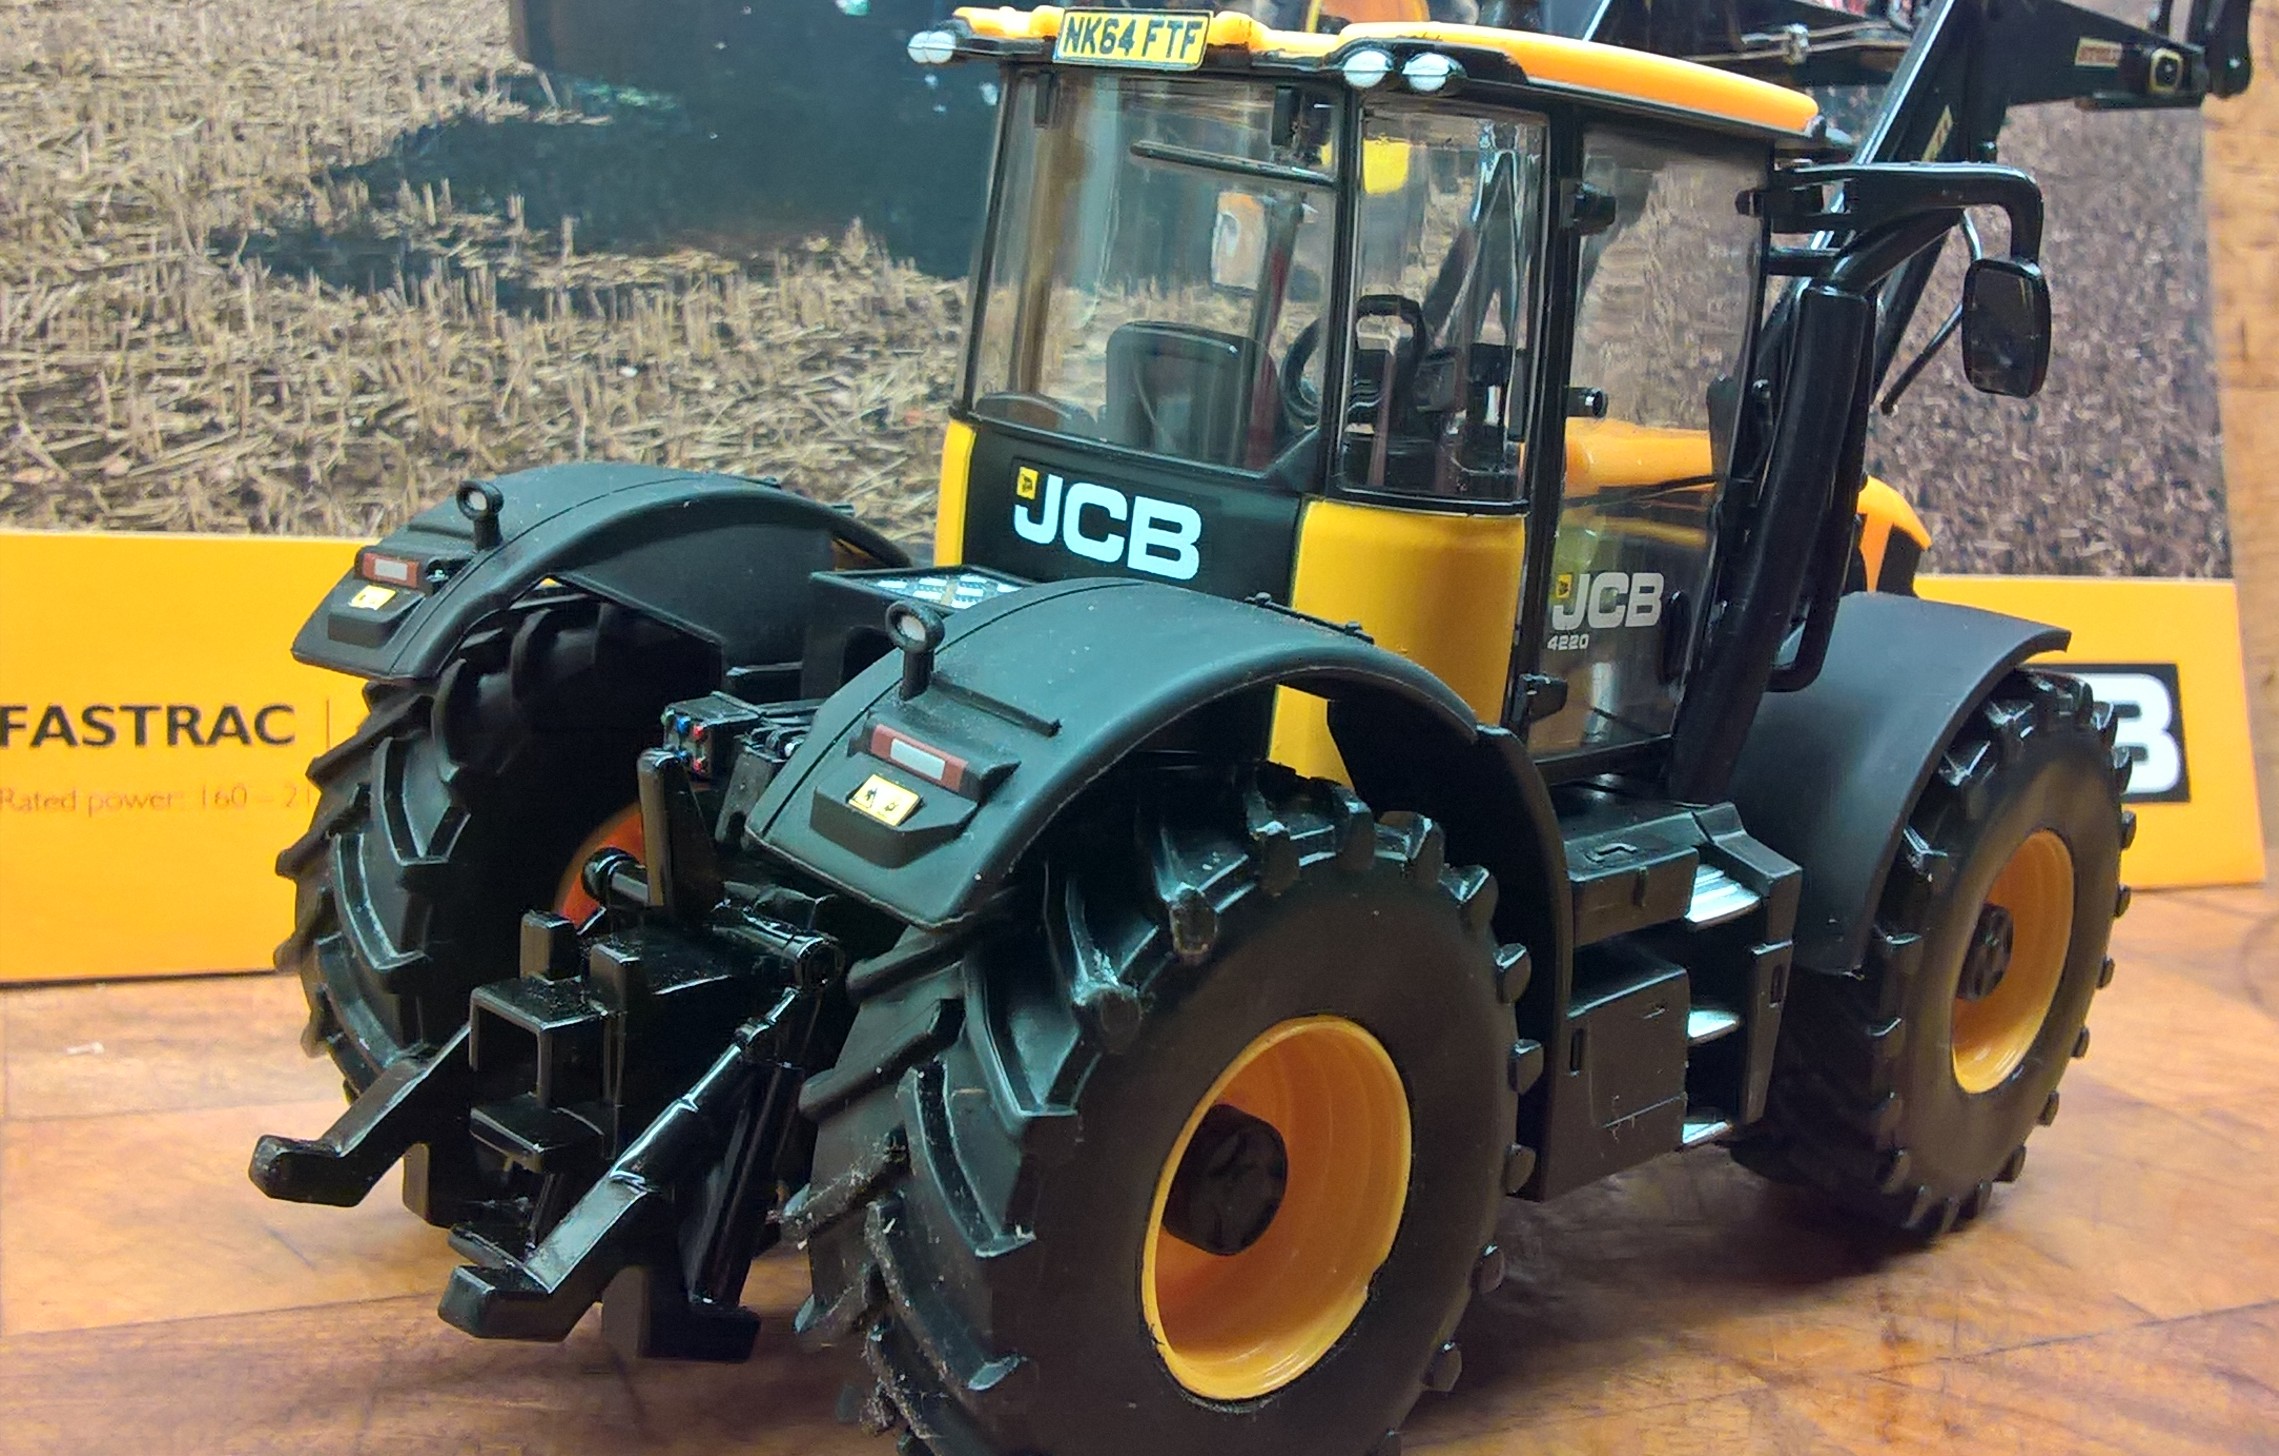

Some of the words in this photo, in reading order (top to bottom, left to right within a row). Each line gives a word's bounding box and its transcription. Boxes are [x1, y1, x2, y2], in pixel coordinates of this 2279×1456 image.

[1062, 16, 1137, 57] NK64
[1141, 19, 1204, 59] FTF
[1013, 473, 1202, 580] JCB
[1552, 572, 1665, 631] JCB
[1547, 633, 1590, 651] 4220
[0, 703, 296, 748] FASTRAC
[2075, 673, 2181, 794] B
[0, 786, 77, 813] Rated
[202, 783, 248, 811] 160
[283, 781, 312, 809] 21
